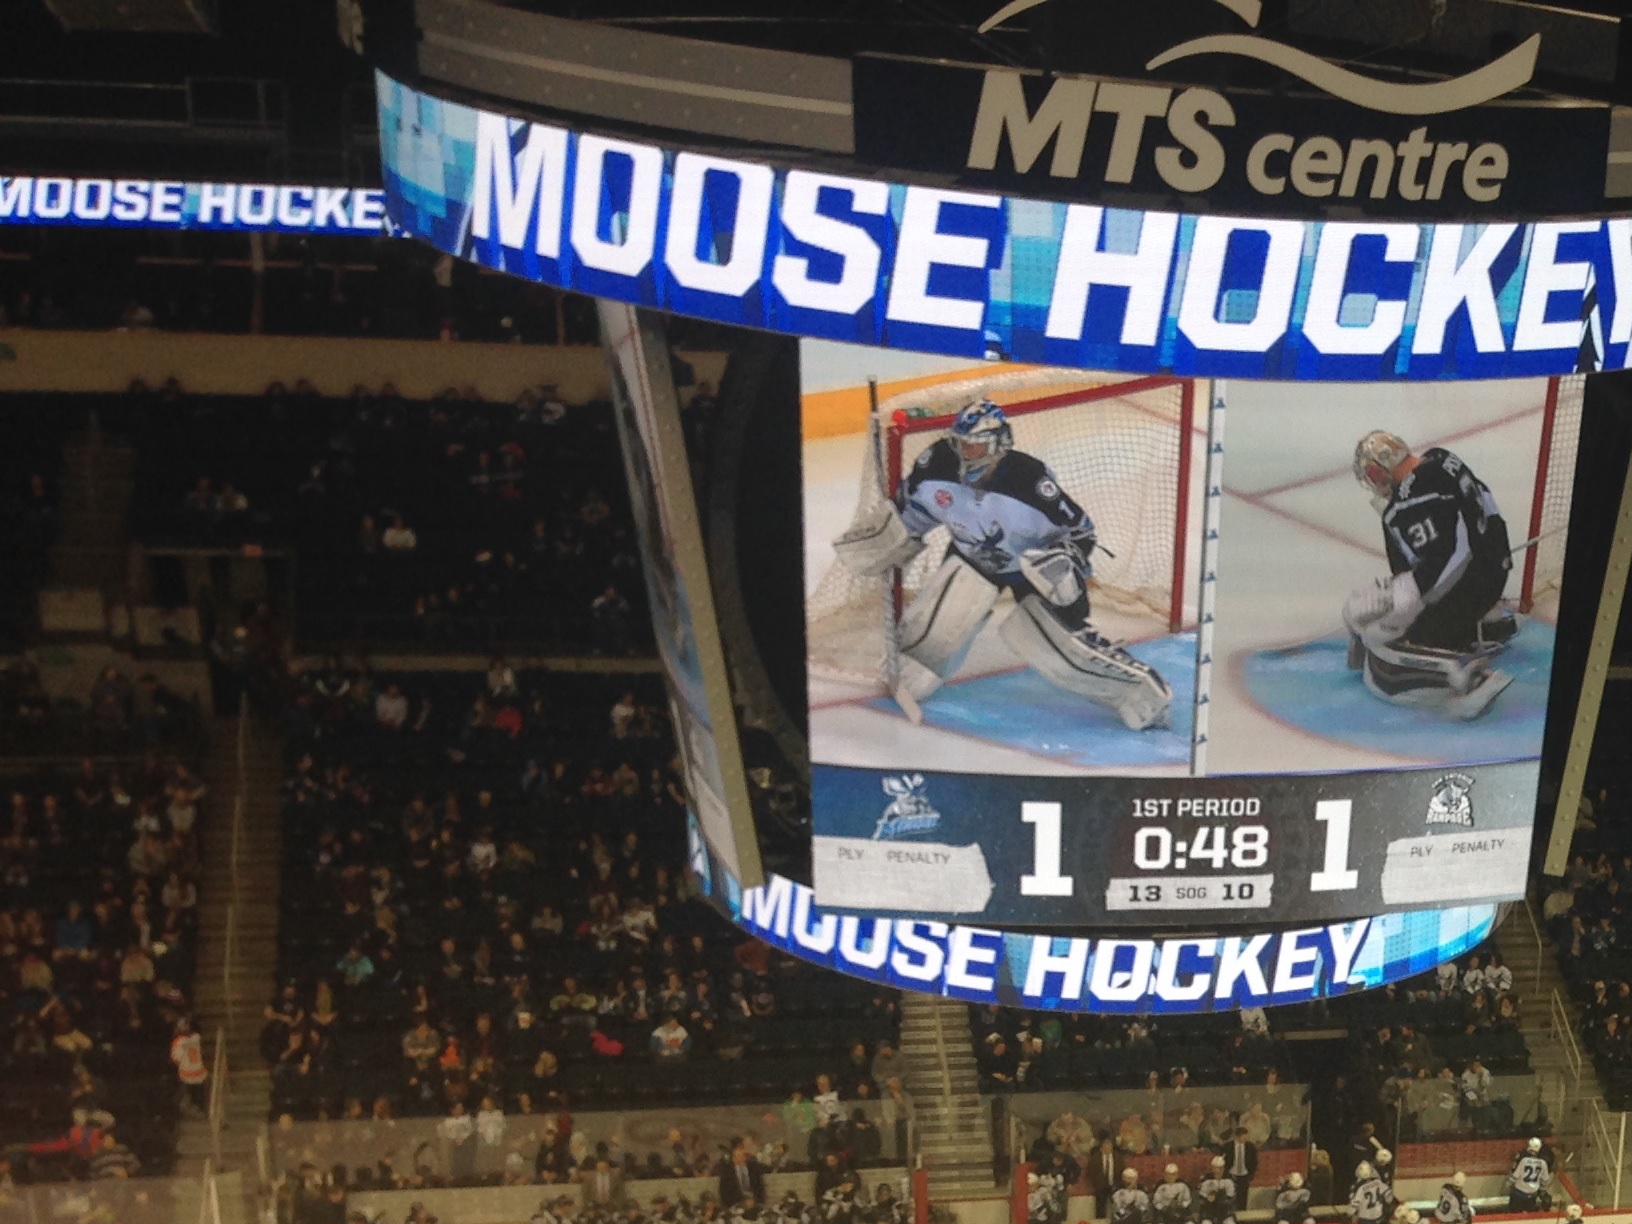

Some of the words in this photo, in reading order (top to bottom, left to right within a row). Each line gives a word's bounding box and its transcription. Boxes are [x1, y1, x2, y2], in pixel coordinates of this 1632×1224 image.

[966, 69, 1236, 195] MTS
[1246, 127, 1510, 202] centre
[0, 176, 183, 222] MOOSE
[198, 182, 387, 230] HOCKE
[470, 109, 1001, 331] MOOSE
[1407, 517, 1438, 549] 31
[1132, 799, 1172, 817] 1ST
[1177, 798, 1260, 816] PERIOD
[837, 847, 863, 861] PLY
[887, 850, 951, 865] PENALTY
[1020, 802, 1073, 896] 1
[1134, 825, 1269, 870] 0:48
[1310, 800, 1358, 891] 1
[1410, 845, 1433, 857] PLY
[1452, 839, 1505, 854] PENALTY
[1129, 885, 1161, 902] 13
[1176, 887, 1207, 900] SOG
[1222, 883, 1254, 900] 10
[742, 873, 1002, 992] MOOSE
[1023, 916, 1372, 1001] HOCKEY
